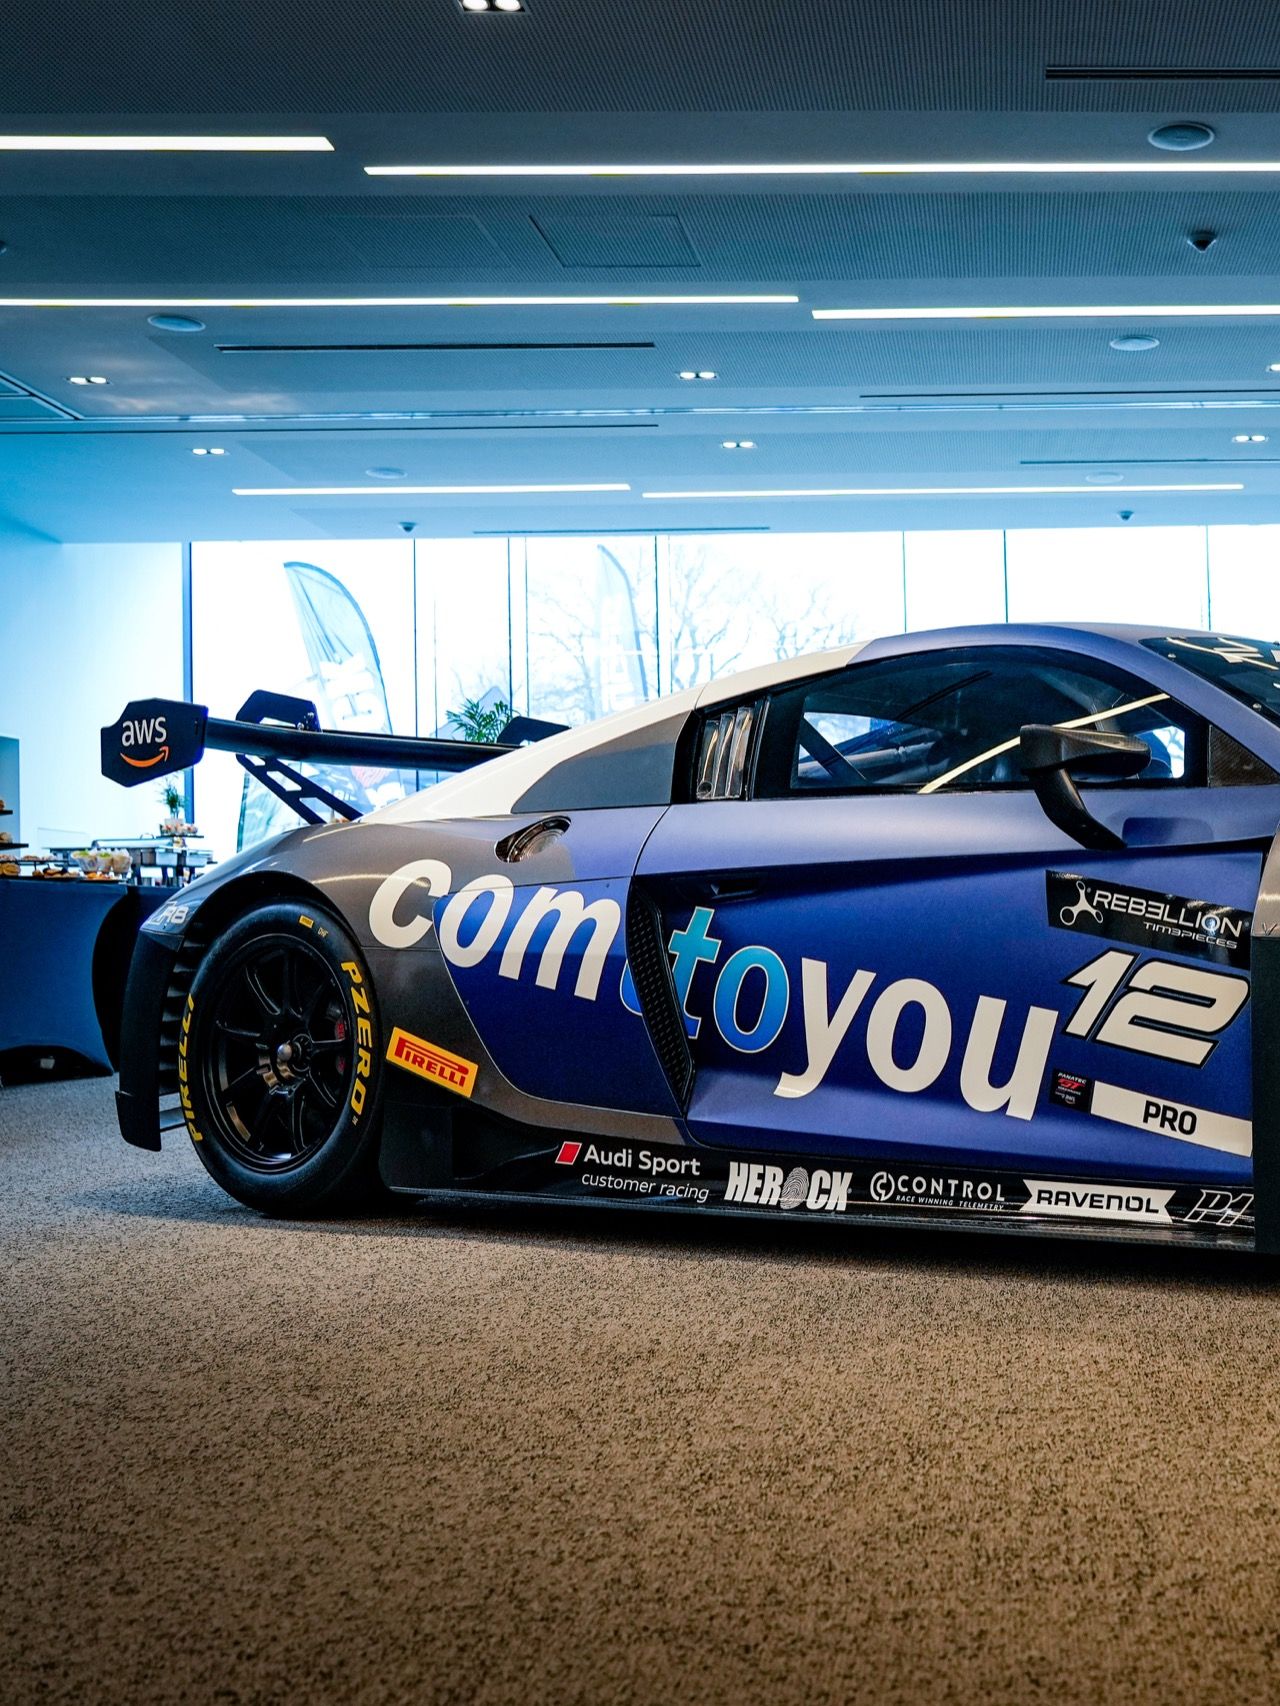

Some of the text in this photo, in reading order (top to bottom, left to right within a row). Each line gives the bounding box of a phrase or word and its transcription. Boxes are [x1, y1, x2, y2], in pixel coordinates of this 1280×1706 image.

[121, 716, 167, 747] aws
[1092, 889, 1243, 938] REBELLION
[1143, 921, 1238, 950] TIMEPIECES
[1062, 948, 1250, 1068] 12
[178, 991, 204, 1143] PIRELLI
[394, 1035, 470, 1088] PIRELLI
[1143, 1099, 1197, 1136] PRO
[584, 1144, 701, 1176] Audi Sport
[581, 1173, 710, 1203] customer racing
[895, 1194, 1005, 1211] RACE WINNING TELEMETRY
[897, 1174, 1005, 1202] CONTROL
[1036, 1189, 1161, 1214] RAVENOL
